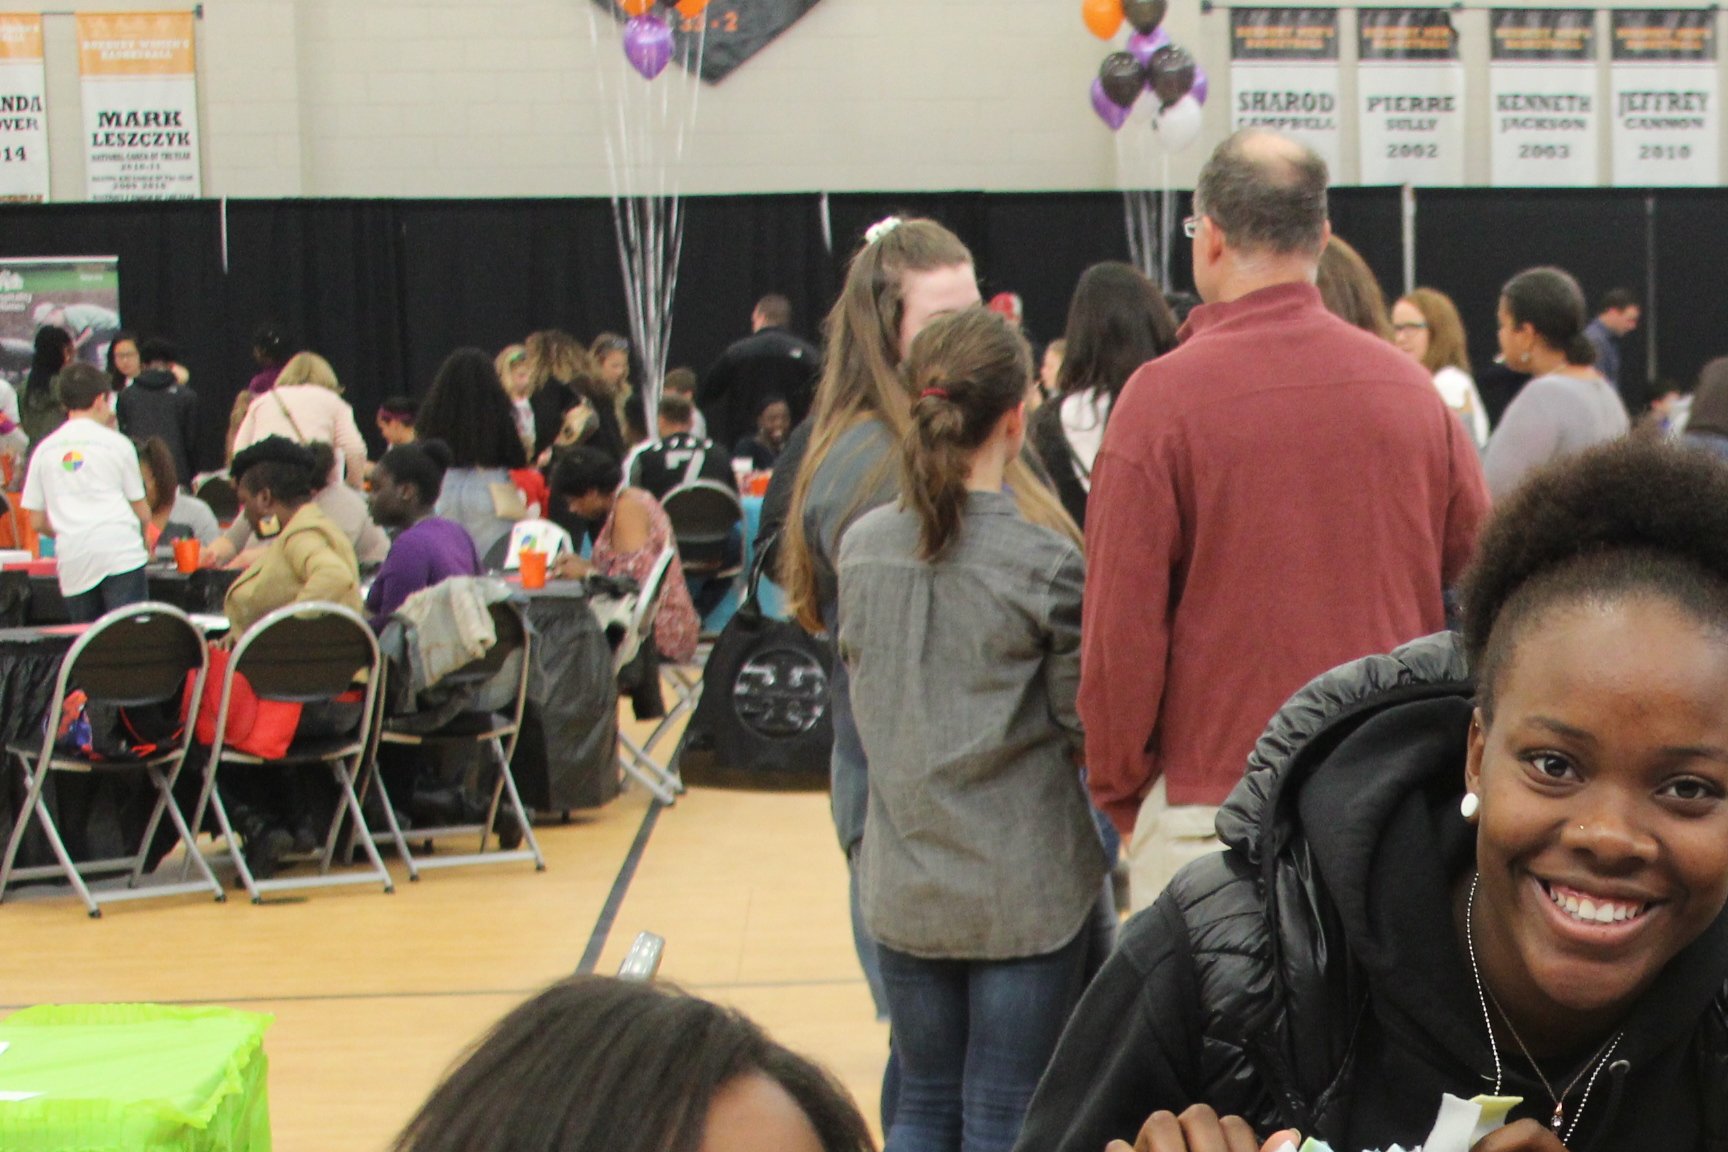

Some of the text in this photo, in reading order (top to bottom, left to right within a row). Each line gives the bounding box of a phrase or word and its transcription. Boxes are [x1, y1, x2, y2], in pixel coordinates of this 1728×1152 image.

[0, 96, 42, 112] NDA
[1238, 92, 1335, 112] SHAROD
[1367, 97, 1455, 112] PIERRE
[1497, 95, 1592, 112] KENNETH
[98, 111, 182, 127] MARK
[1502, 118, 1587, 133] JACKSON
[91, 132, 191, 147] LESZCZYK
[1638, 145, 1692, 160] 2010
